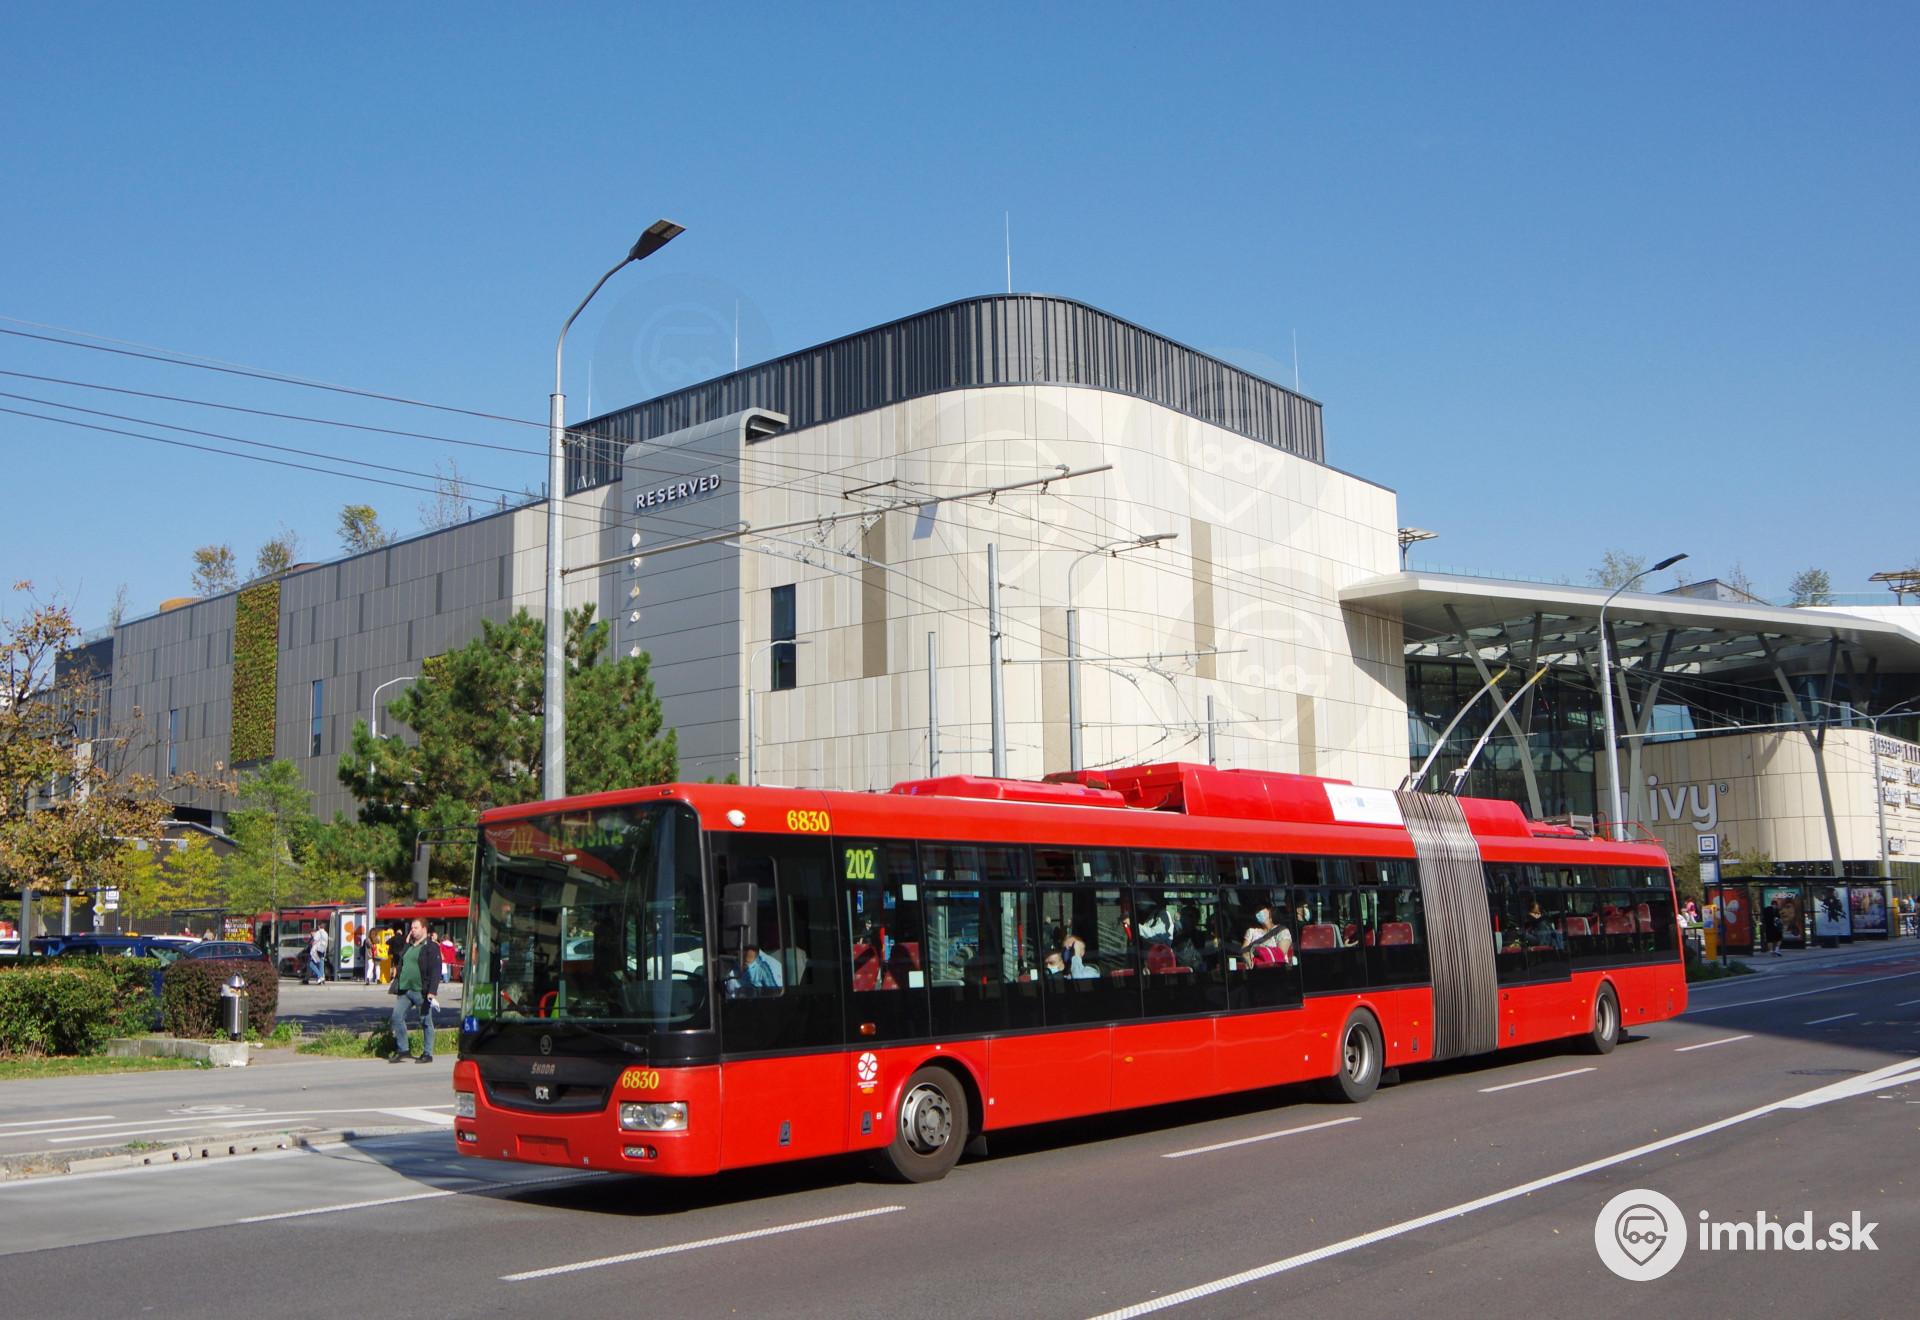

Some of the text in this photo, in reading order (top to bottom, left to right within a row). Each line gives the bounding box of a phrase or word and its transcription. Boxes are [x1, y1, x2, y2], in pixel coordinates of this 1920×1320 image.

[635, 474, 721, 509] RESERVED
[786, 810, 831, 832] 6830
[845, 849, 875, 879] 202
[474, 993, 493, 1010] 202
[622, 1071, 660, 1089] 6830
